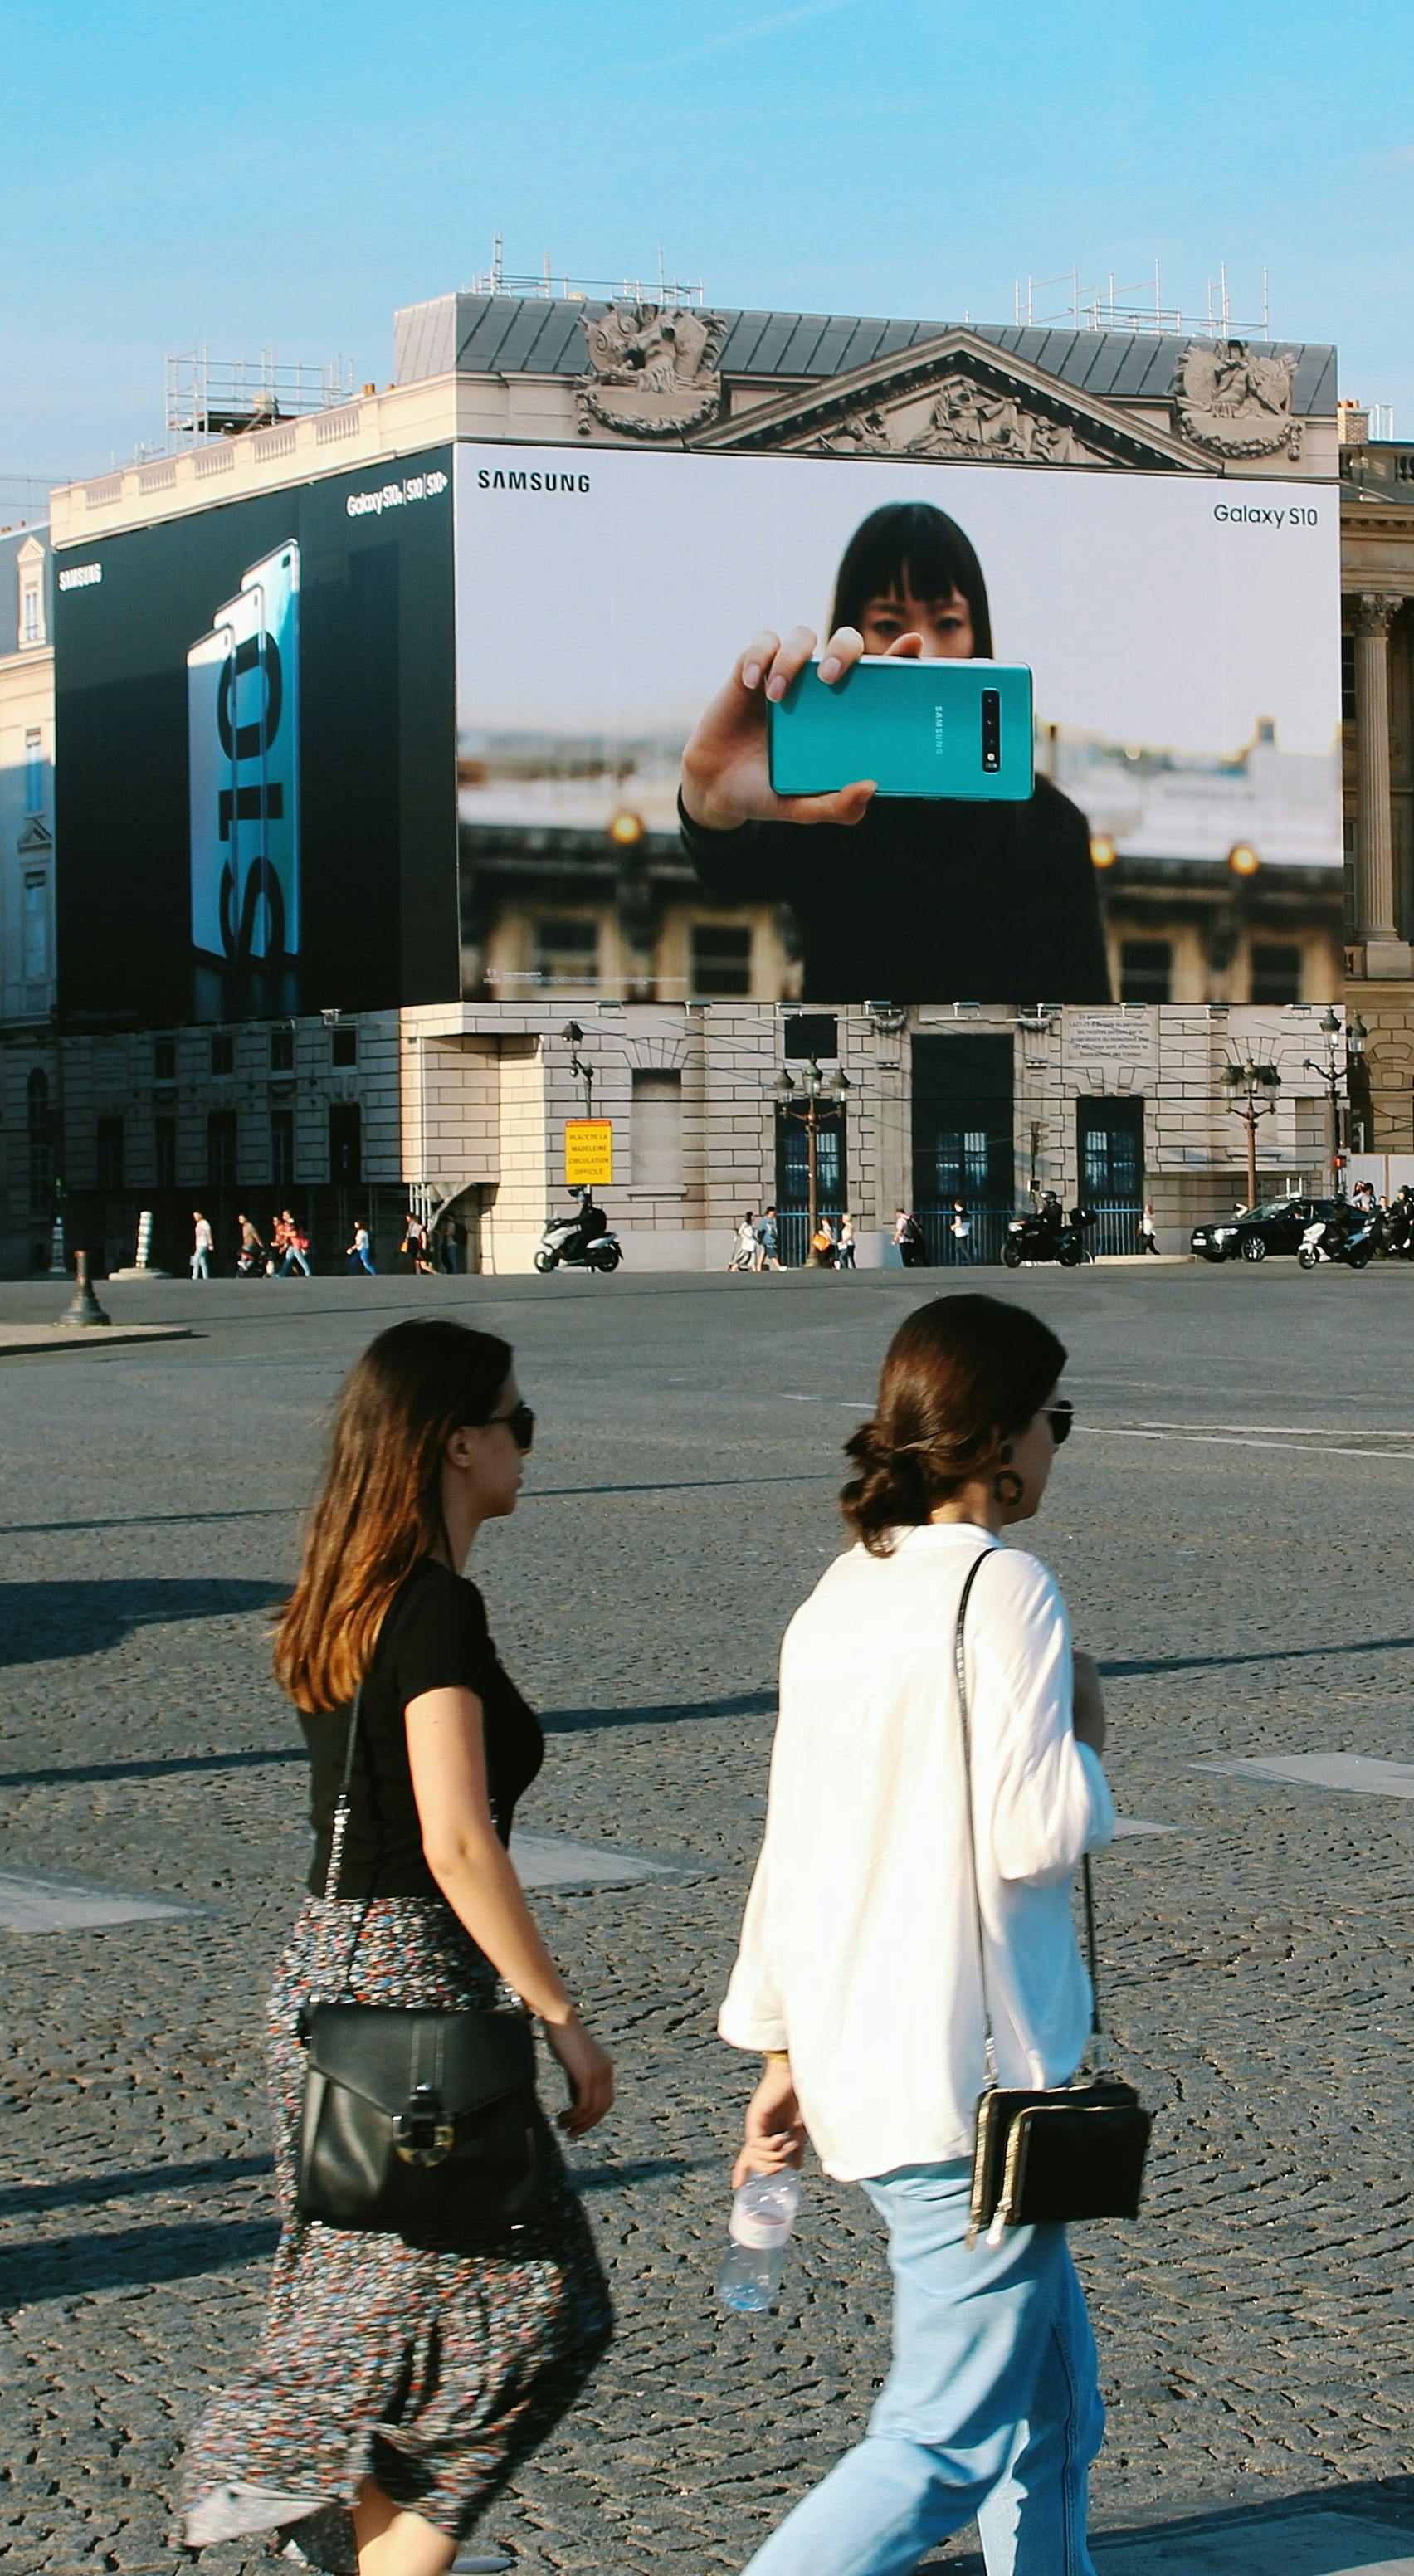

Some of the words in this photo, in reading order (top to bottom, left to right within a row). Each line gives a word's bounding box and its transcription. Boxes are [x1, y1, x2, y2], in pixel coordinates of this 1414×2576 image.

[347, 492, 383, 517] Galaxy
[407, 477, 423, 501] S10
[477, 469, 591, 493] SAMSUNG
[1213, 504, 1285, 529] Galaxy
[1289, 507, 1318, 525] S10
[59, 564, 102, 592] SAMSUNG
[934, 705, 943, 755] SAMSUNG
[217, 630, 285, 961] S10
